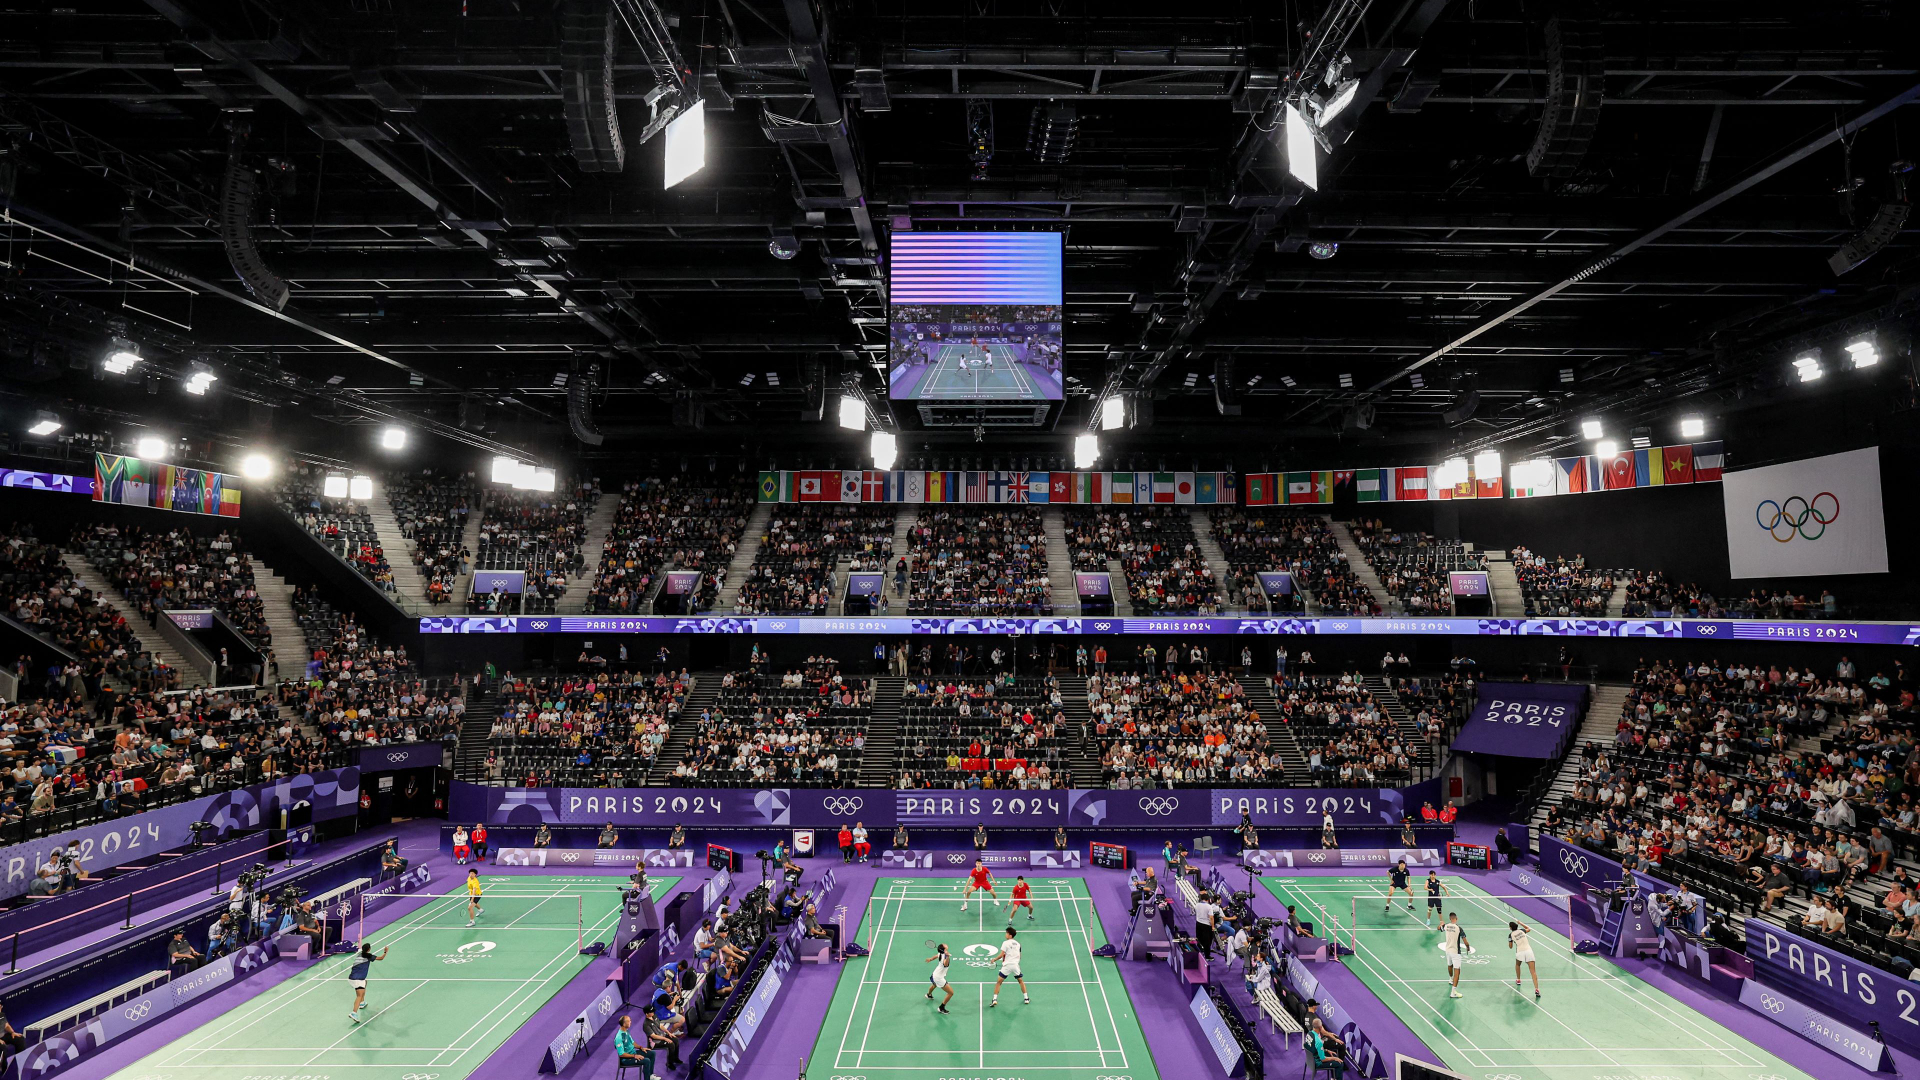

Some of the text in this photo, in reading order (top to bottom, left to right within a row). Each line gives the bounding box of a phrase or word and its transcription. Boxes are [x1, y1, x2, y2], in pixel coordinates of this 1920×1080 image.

[620, 621, 648, 630] 2024
[859, 622, 887, 630] 2024
[1181, 622, 1211, 630] 2024
[1420, 623, 1451, 631] 2024
[1816, 628, 1858, 640] 2024
[1484, 711, 1561, 728] 2024
[654, 796, 721, 814] 2024
[992, 798, 1060, 815] 2024
[1306, 797, 1371, 814] 2024
[79, 822, 160, 863] 2024
[1007, 855, 1027, 863] 2024
[1367, 854, 1387, 862] 2024
[630, 924, 637, 932] 2
[1147, 926, 1152, 934] 1
[1635, 923, 1642, 931] 3
[1843, 1038, 1873, 1060] 2024
